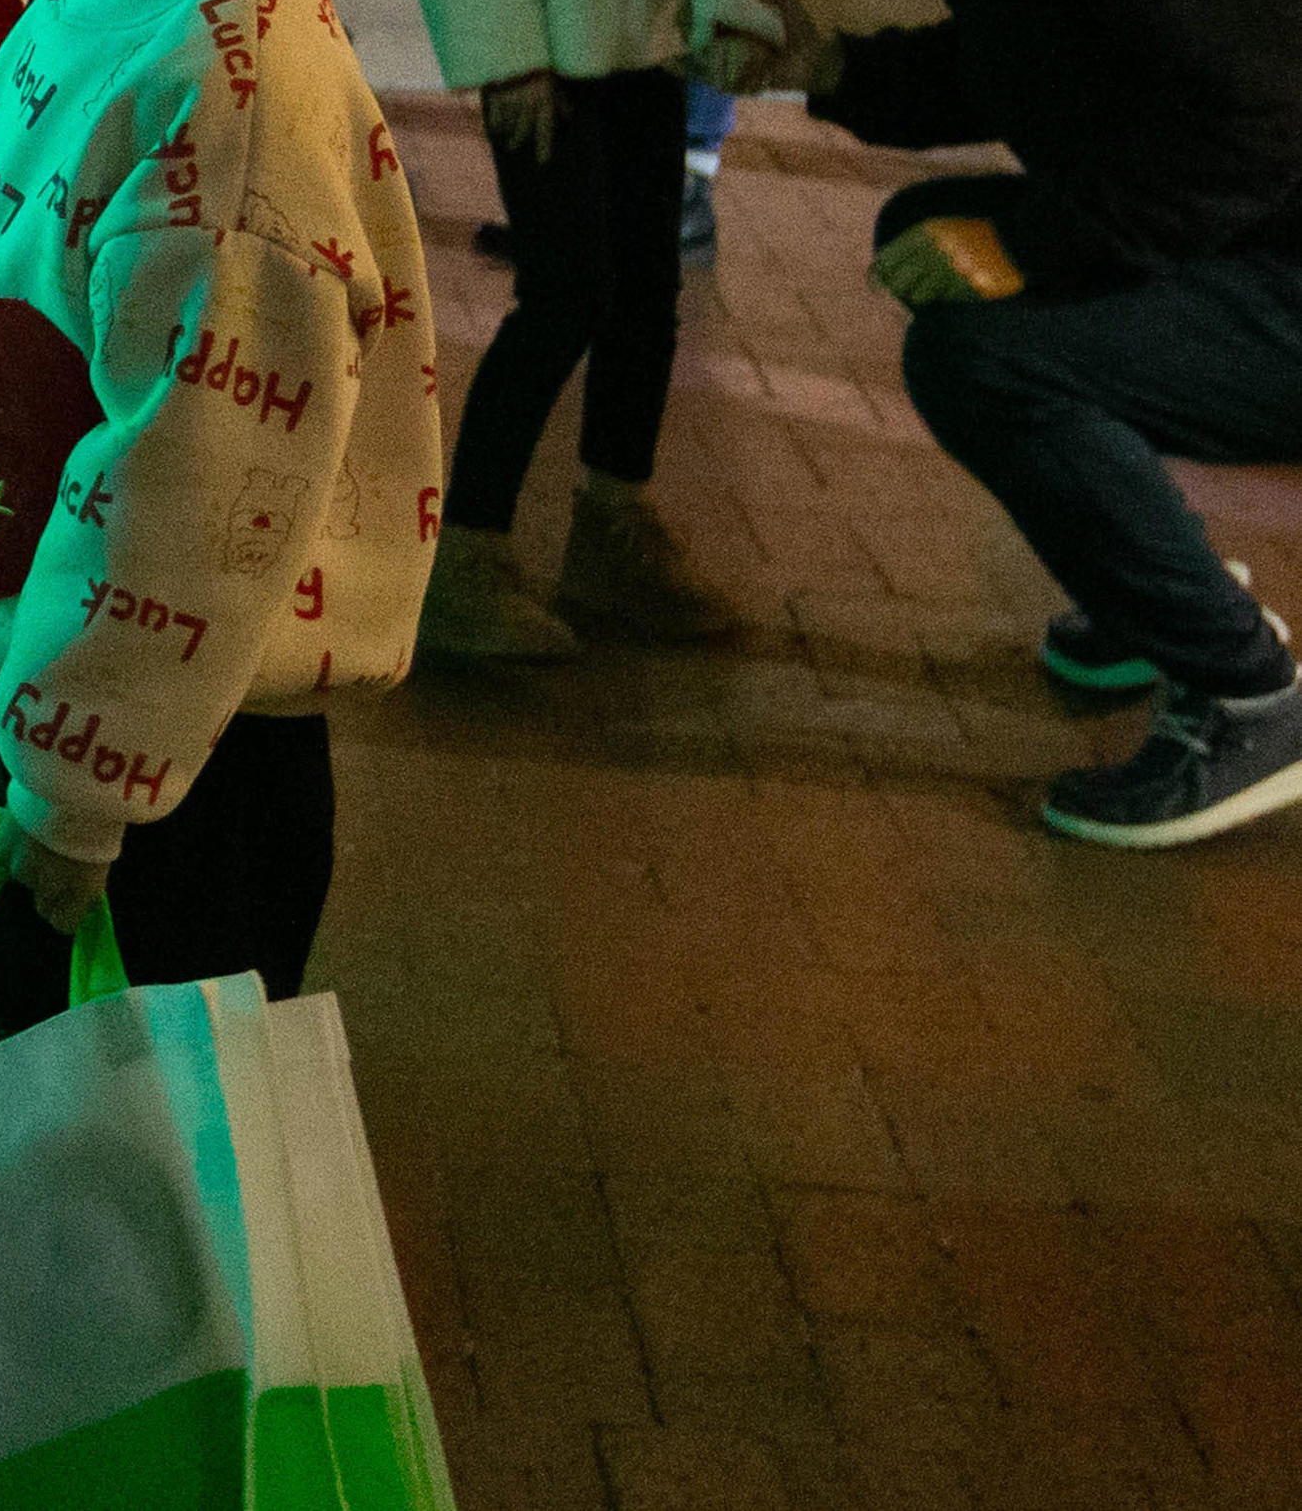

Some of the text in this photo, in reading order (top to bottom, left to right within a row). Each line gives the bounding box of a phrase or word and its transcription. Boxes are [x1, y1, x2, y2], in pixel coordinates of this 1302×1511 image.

[146, 122, 216, 242] uck
[81, 577, 208, 664] Luck
[1, 682, 172, 806] Happy
